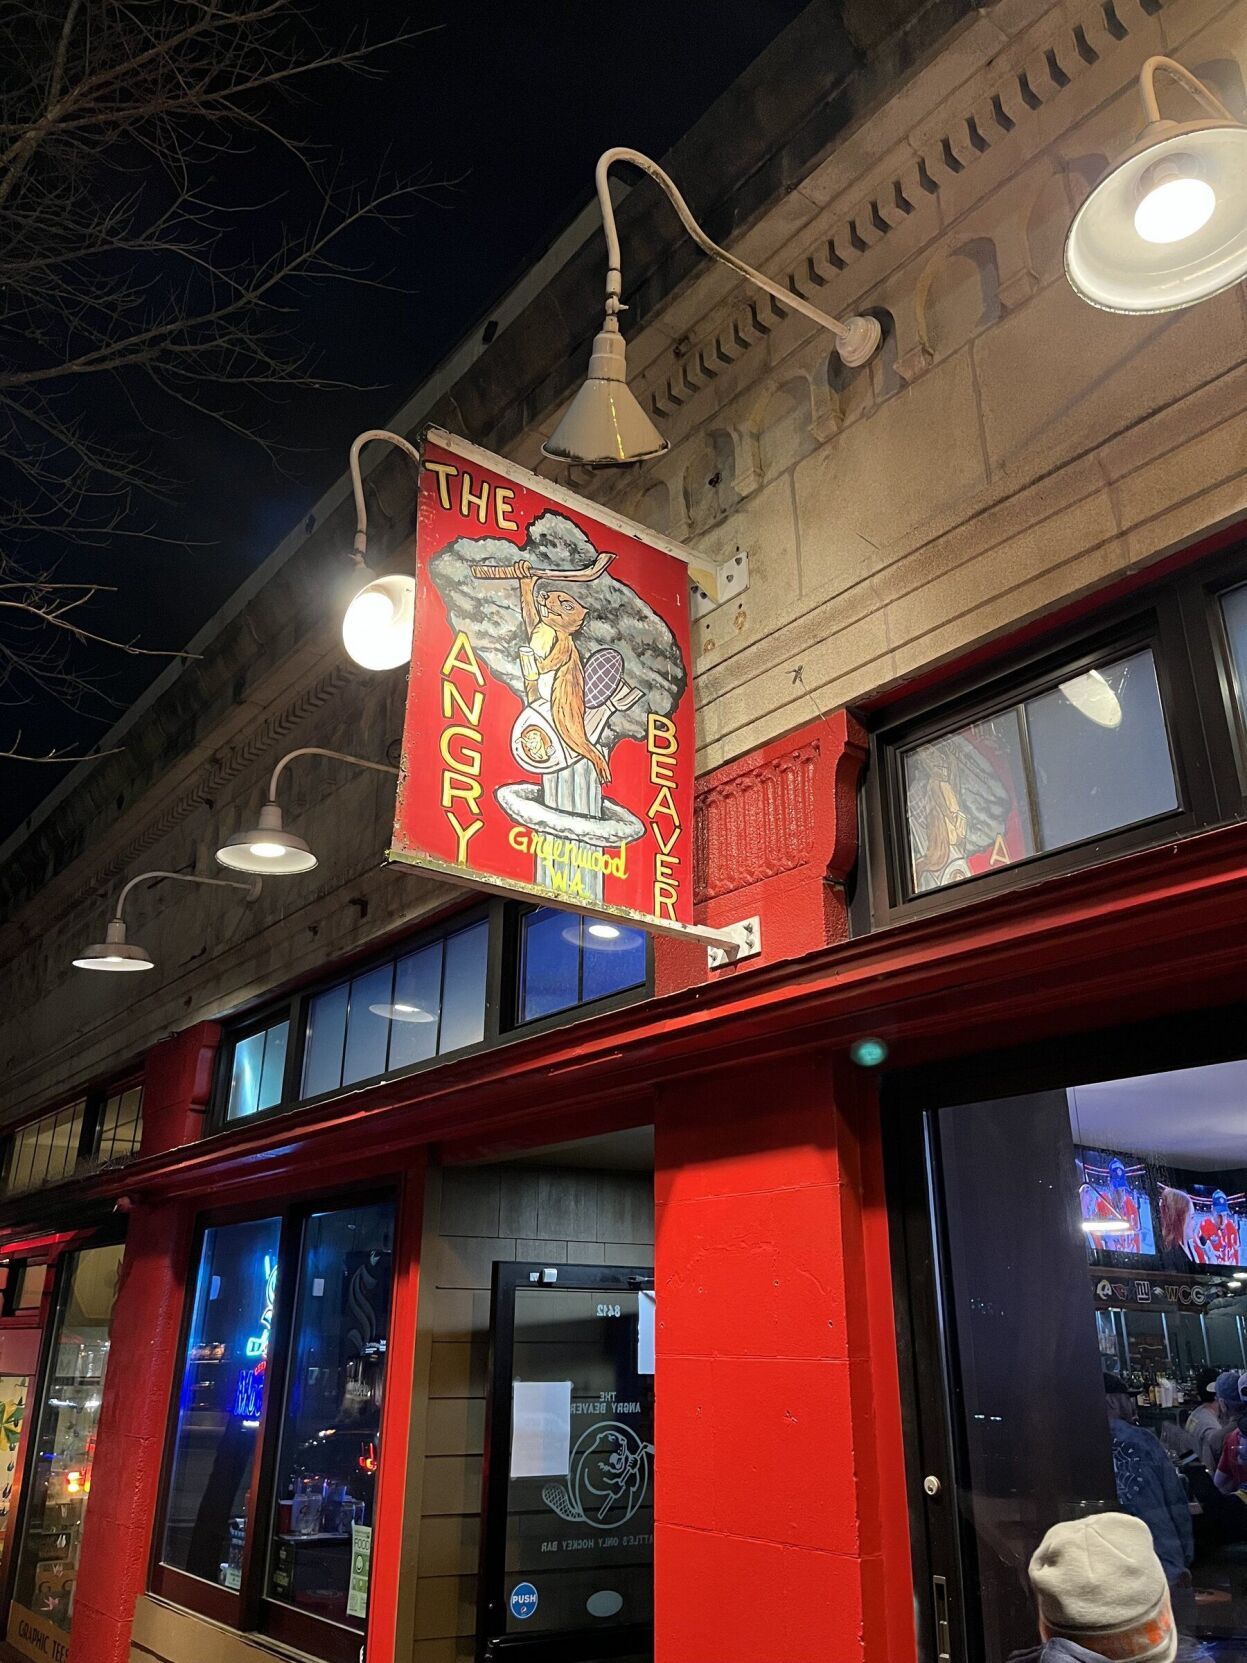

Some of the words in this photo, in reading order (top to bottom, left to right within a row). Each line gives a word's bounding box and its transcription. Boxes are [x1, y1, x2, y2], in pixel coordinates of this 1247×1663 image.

[424, 460, 519, 531] THE
[440, 631, 486, 868] ANGRY
[646, 712, 680, 921] BEAVER
[508, 826, 629, 879] Greenwood
[512, 1594, 536, 1604] PUSH
[18, 1620, 49, 1655] GRAPHIC
